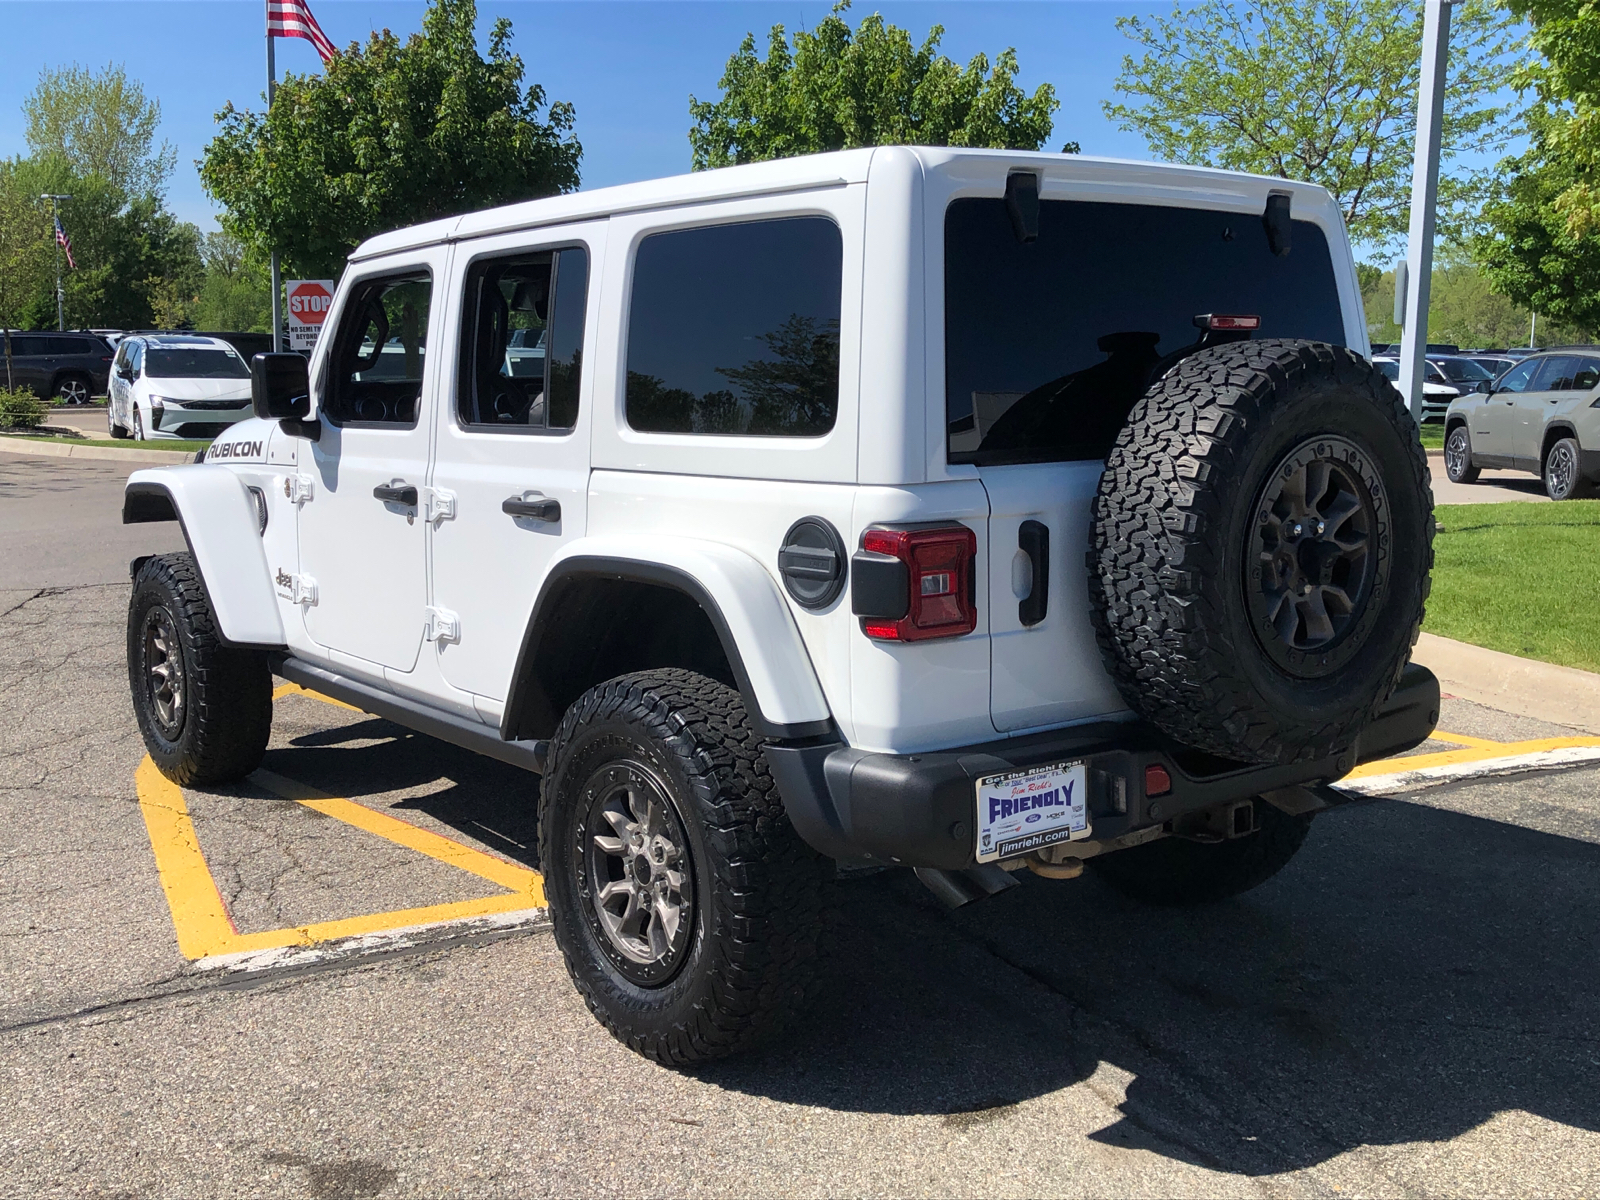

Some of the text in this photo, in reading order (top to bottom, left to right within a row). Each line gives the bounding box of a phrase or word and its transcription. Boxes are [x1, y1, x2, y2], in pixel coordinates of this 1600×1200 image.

[291, 295, 331, 313] STOP
[208, 440, 264, 459] RUBICON
[985, 759, 1081, 784] Get the Riehl Deal
[1011, 780, 1052, 798] Jim Riehl's
[988, 779, 1075, 825] FRIENDLY
[1000, 829, 1069, 856] jimriehl.com
